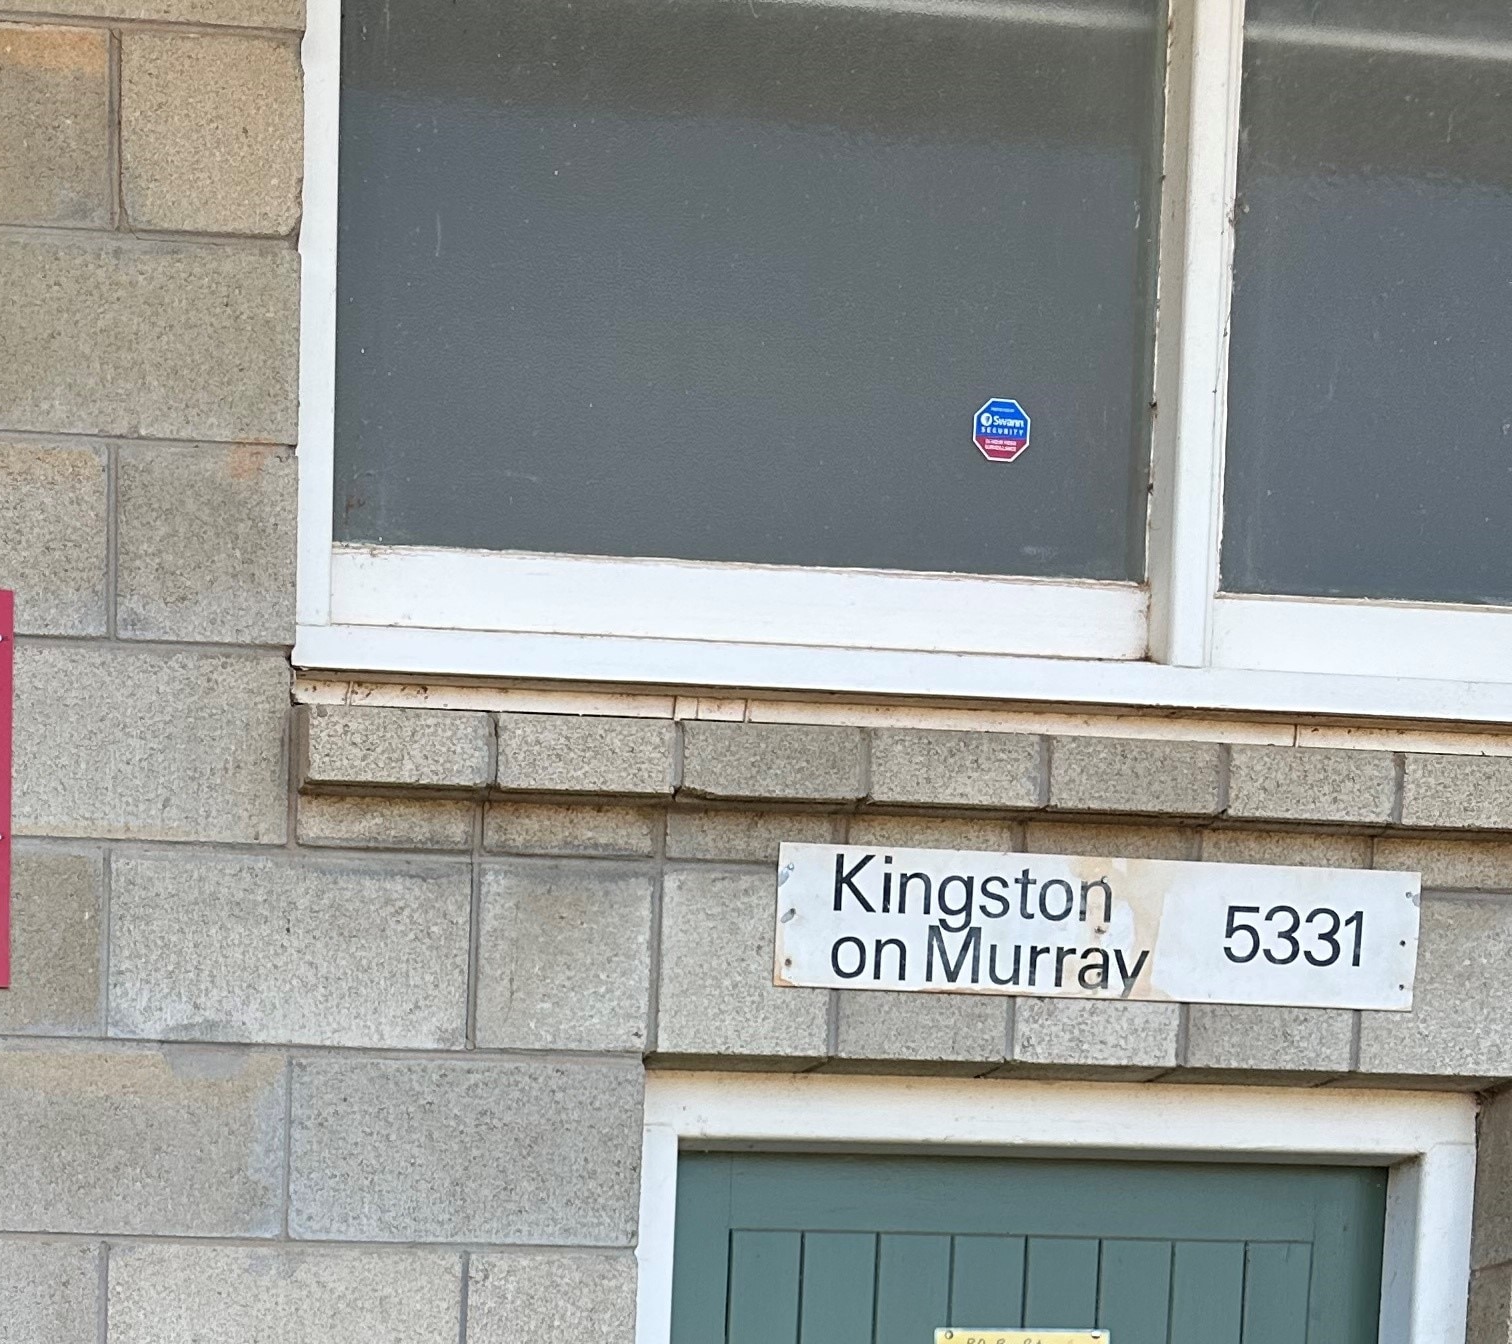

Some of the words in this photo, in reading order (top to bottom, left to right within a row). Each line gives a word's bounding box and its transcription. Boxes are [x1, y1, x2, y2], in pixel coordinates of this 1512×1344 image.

[832, 853, 1113, 933] Kingston
[831, 935, 907, 982] on
[926, 925, 1150, 999] Murray
[1222, 905, 1365, 968] 5331
